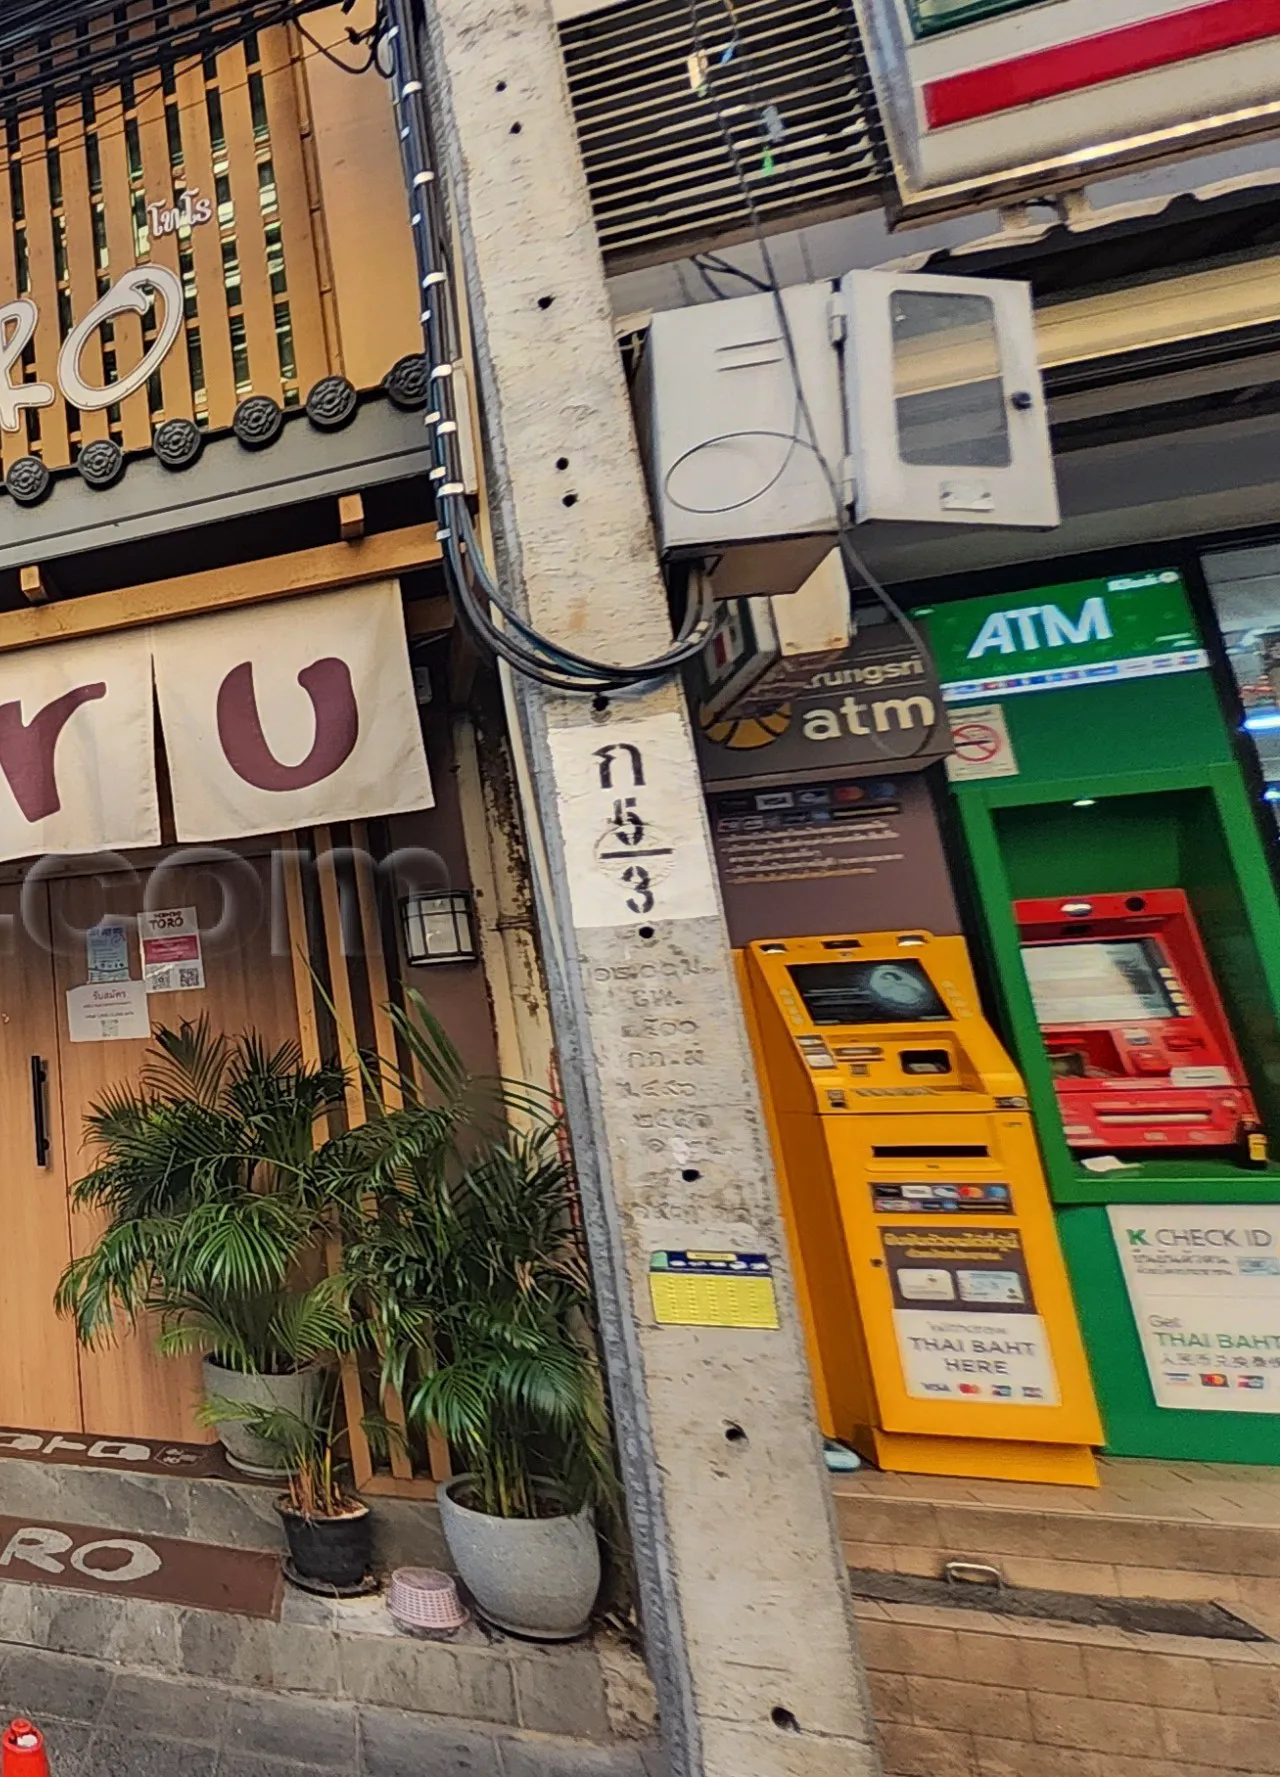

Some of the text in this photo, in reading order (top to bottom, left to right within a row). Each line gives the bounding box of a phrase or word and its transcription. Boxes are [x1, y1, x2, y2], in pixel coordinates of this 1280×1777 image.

[146, 188, 212, 236] โทโร
[967, 597, 1114, 659] ATM
[805, 654, 925, 688] rungsri
[803, 695, 935, 741] atm
[592, 743, 645, 788] ก
[622, 866, 655, 913] 3
[148, 916, 185, 931] TORO
[1126, 1228, 1272, 1247] K CHECK ID
[908, 1336, 1036, 1355] THAI BAHT
[1153, 1332, 1280, 1350] THAI BAHT
[944, 1358, 1009, 1375] HERE
